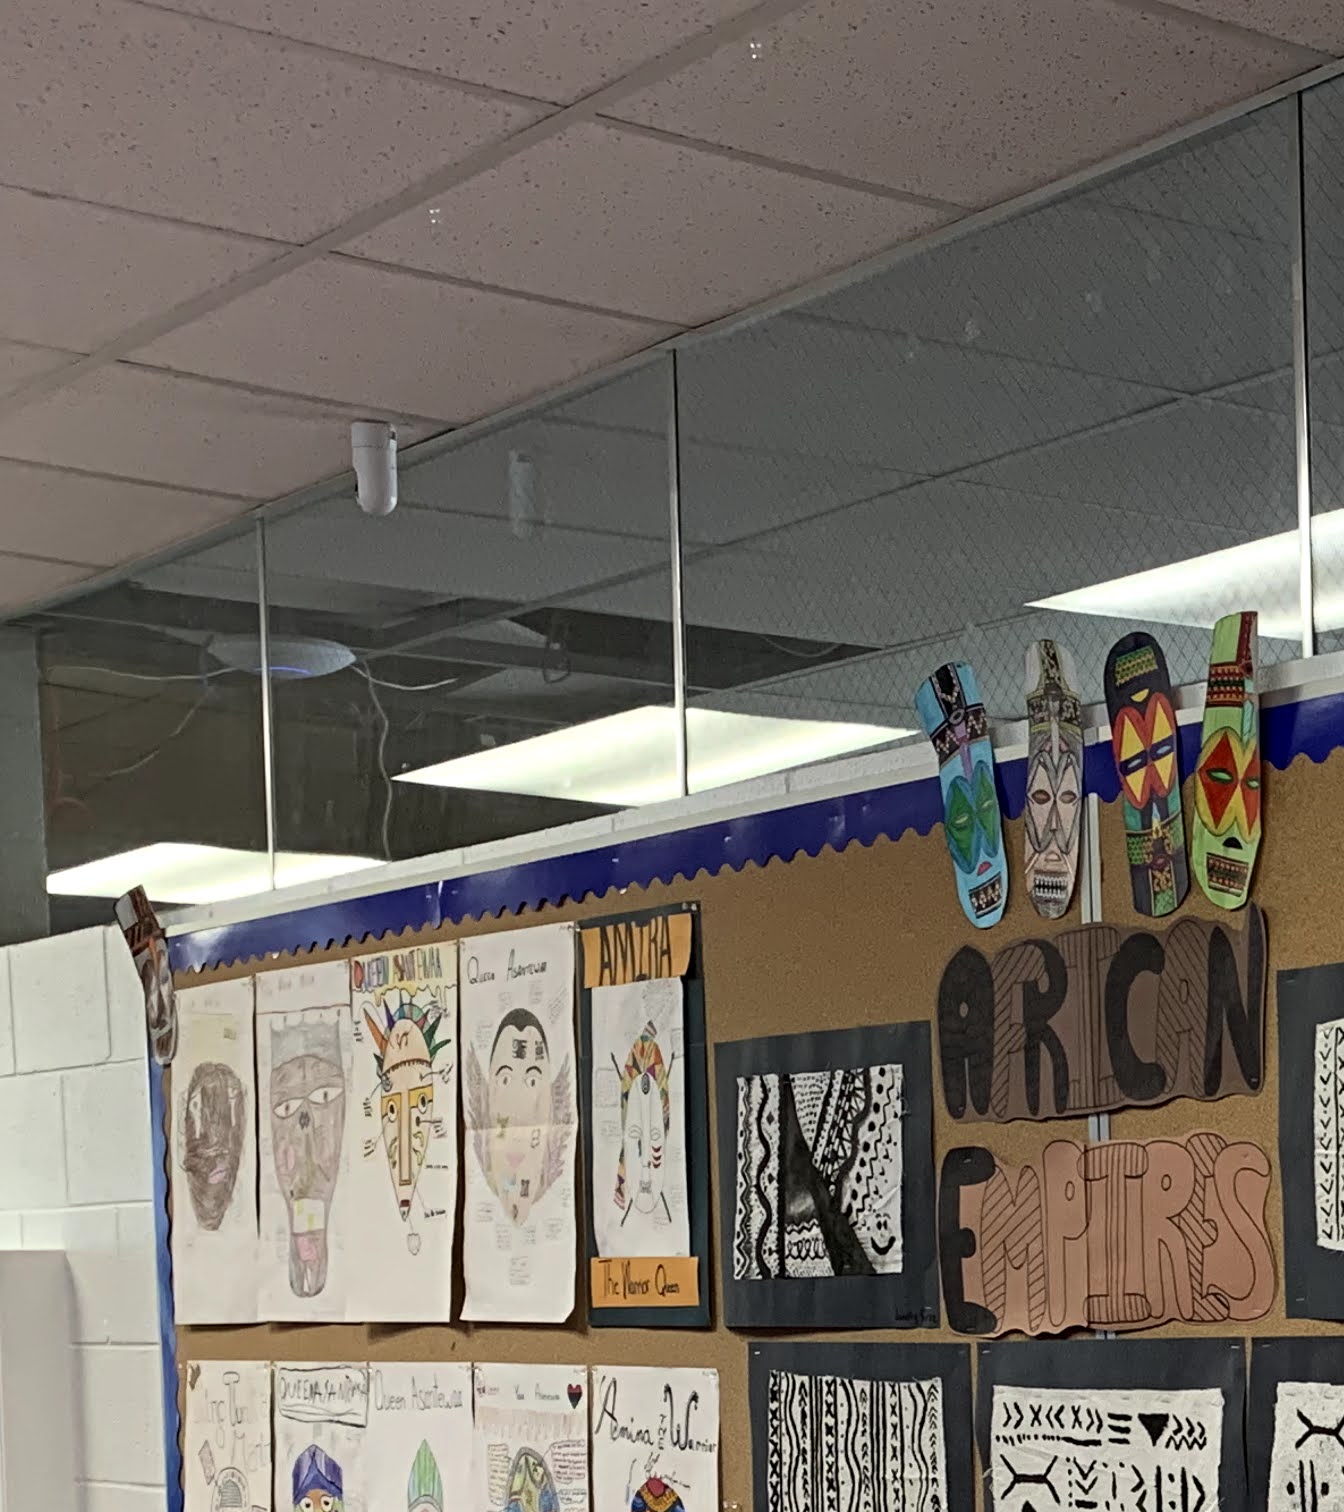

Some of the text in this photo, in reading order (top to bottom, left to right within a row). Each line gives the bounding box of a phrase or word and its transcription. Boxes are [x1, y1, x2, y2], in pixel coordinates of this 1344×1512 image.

[598, 1260, 619, 1297] The
[655, 1264, 679, 1297] Queen
[938, 1132, 1279, 1336] EMPIRES
